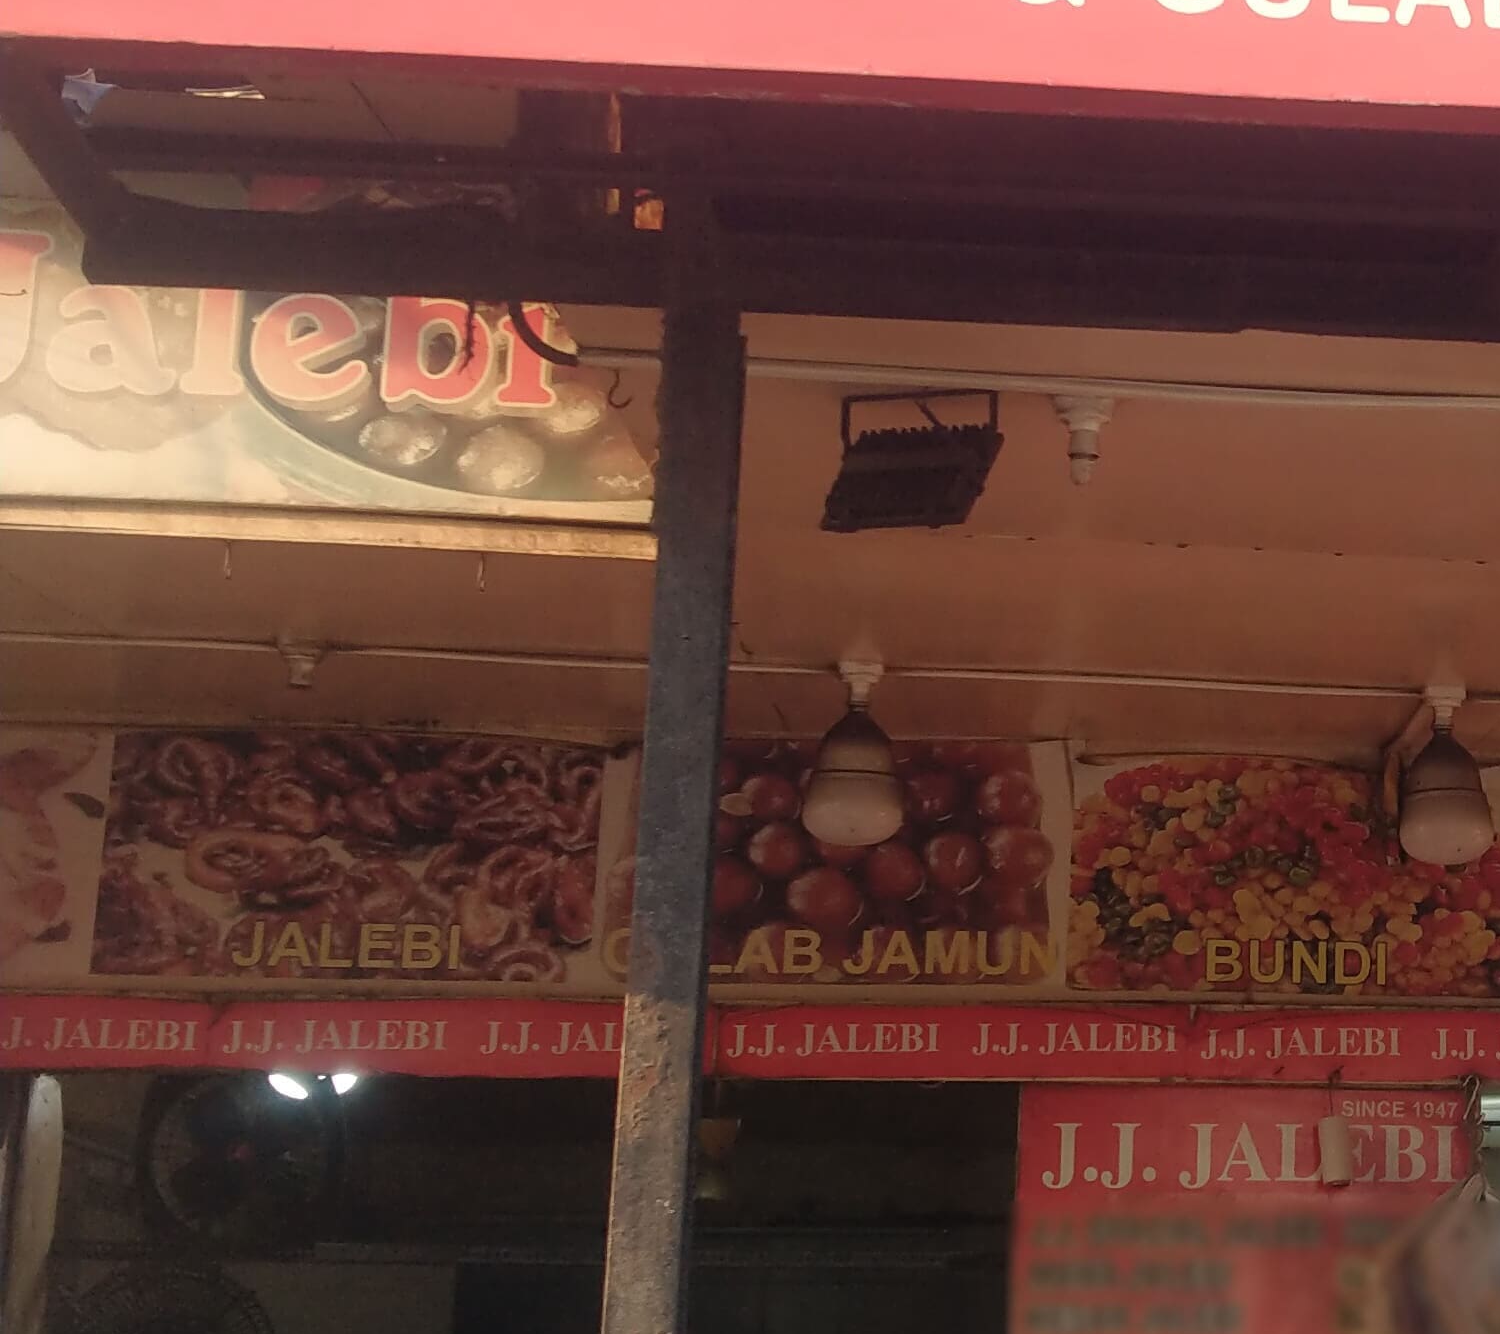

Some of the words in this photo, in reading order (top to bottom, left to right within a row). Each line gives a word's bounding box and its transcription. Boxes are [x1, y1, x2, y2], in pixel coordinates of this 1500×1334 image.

[232, 921, 462, 970] JALEBI
[844, 930, 1060, 976] JAMUN
[1204, 938, 1387, 986] BUNDI
[44, 1017, 200, 1052] JALEBI
[223, 1020, 284, 1054] J.J.
[295, 1020, 447, 1054] JALEBI
[480, 1021, 540, 1055] J.J.
[552, 1022, 622, 1055] JAL
[727, 1023, 785, 1058] J.J.
[796, 1023, 941, 1057] JALEBI
[973, 1024, 1029, 1056] J.J.
[1038, 1023, 1177, 1057] JALEBI
[1200, 1028, 1256, 1060] J.J.
[1266, 1027, 1402, 1059] JALEBI
[1431, 1028, 1486, 1060] J.J.
[1341, 1100, 1407, 1117] SINCE
[1413, 1102, 1458, 1119] 1947
[1042, 1123, 1157, 1189] J.J.
